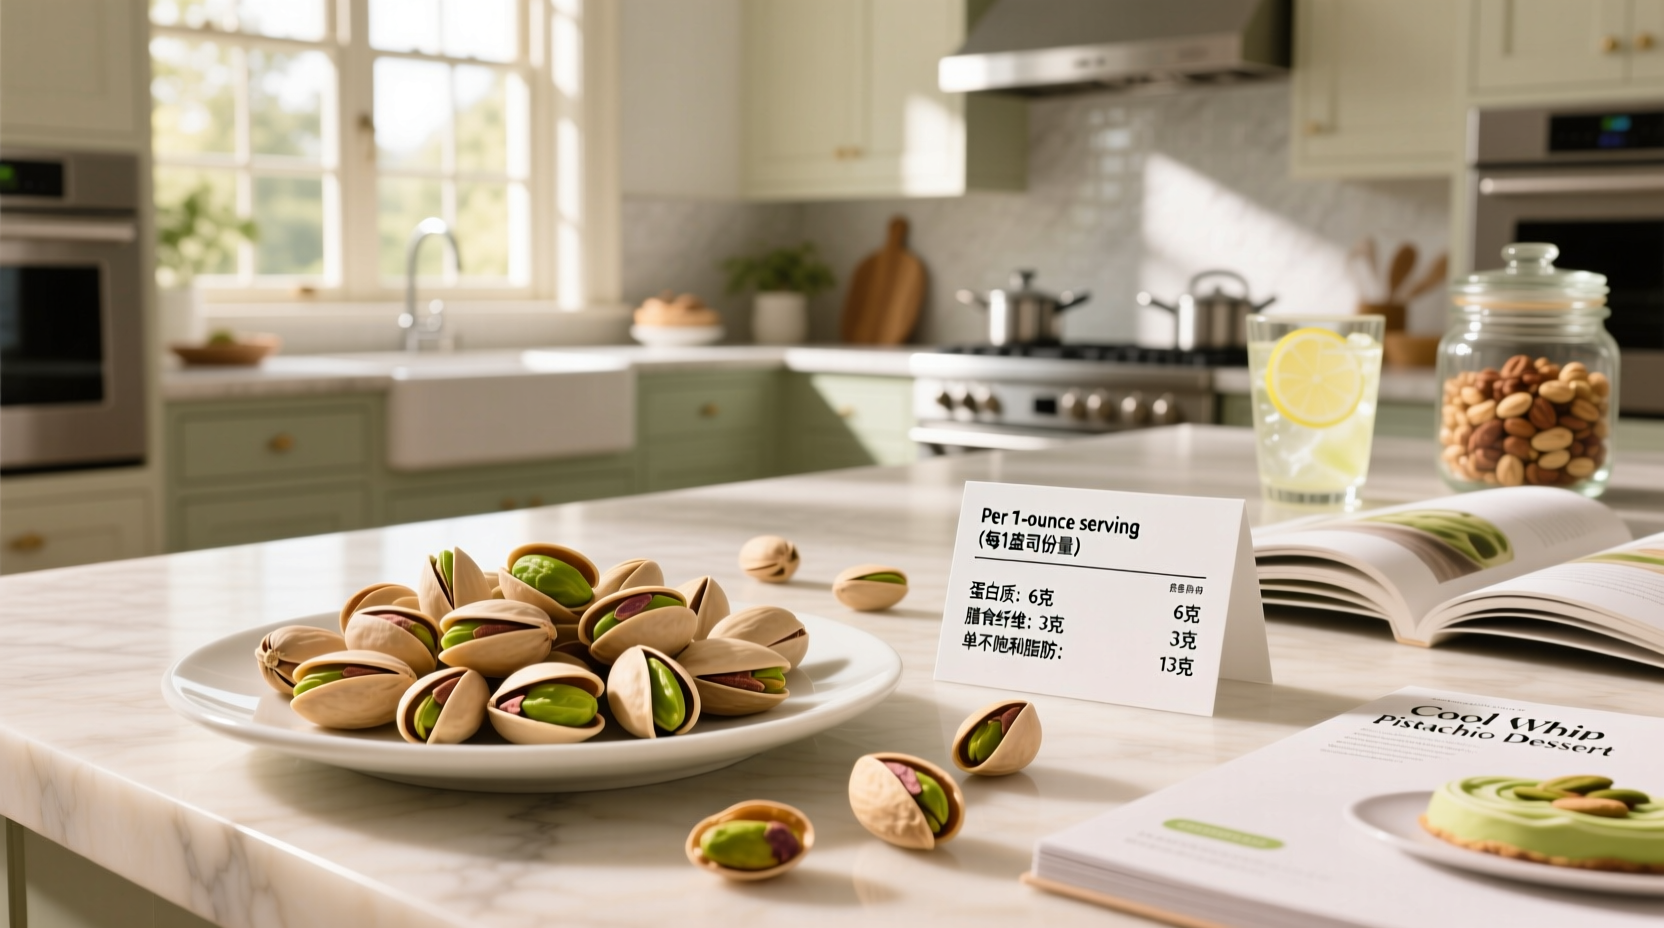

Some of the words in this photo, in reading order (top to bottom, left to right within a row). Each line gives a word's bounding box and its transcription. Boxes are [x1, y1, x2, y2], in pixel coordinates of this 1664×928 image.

[981, 507, 1008, 526] Per
[1012, 509, 1076, 530] 1-ounce
[1079, 515, 1141, 540] serving
[1173, 603, 1202, 624] 6克
[1169, 629, 1198, 651] 3克
[1159, 656, 1195, 677] 13克
[1373, 713, 1495, 739] Pistachio
[1503, 732, 1613, 757] Dessert
[1410, 705, 1500, 726] Cool
[1509, 716, 1605, 741] Whip
